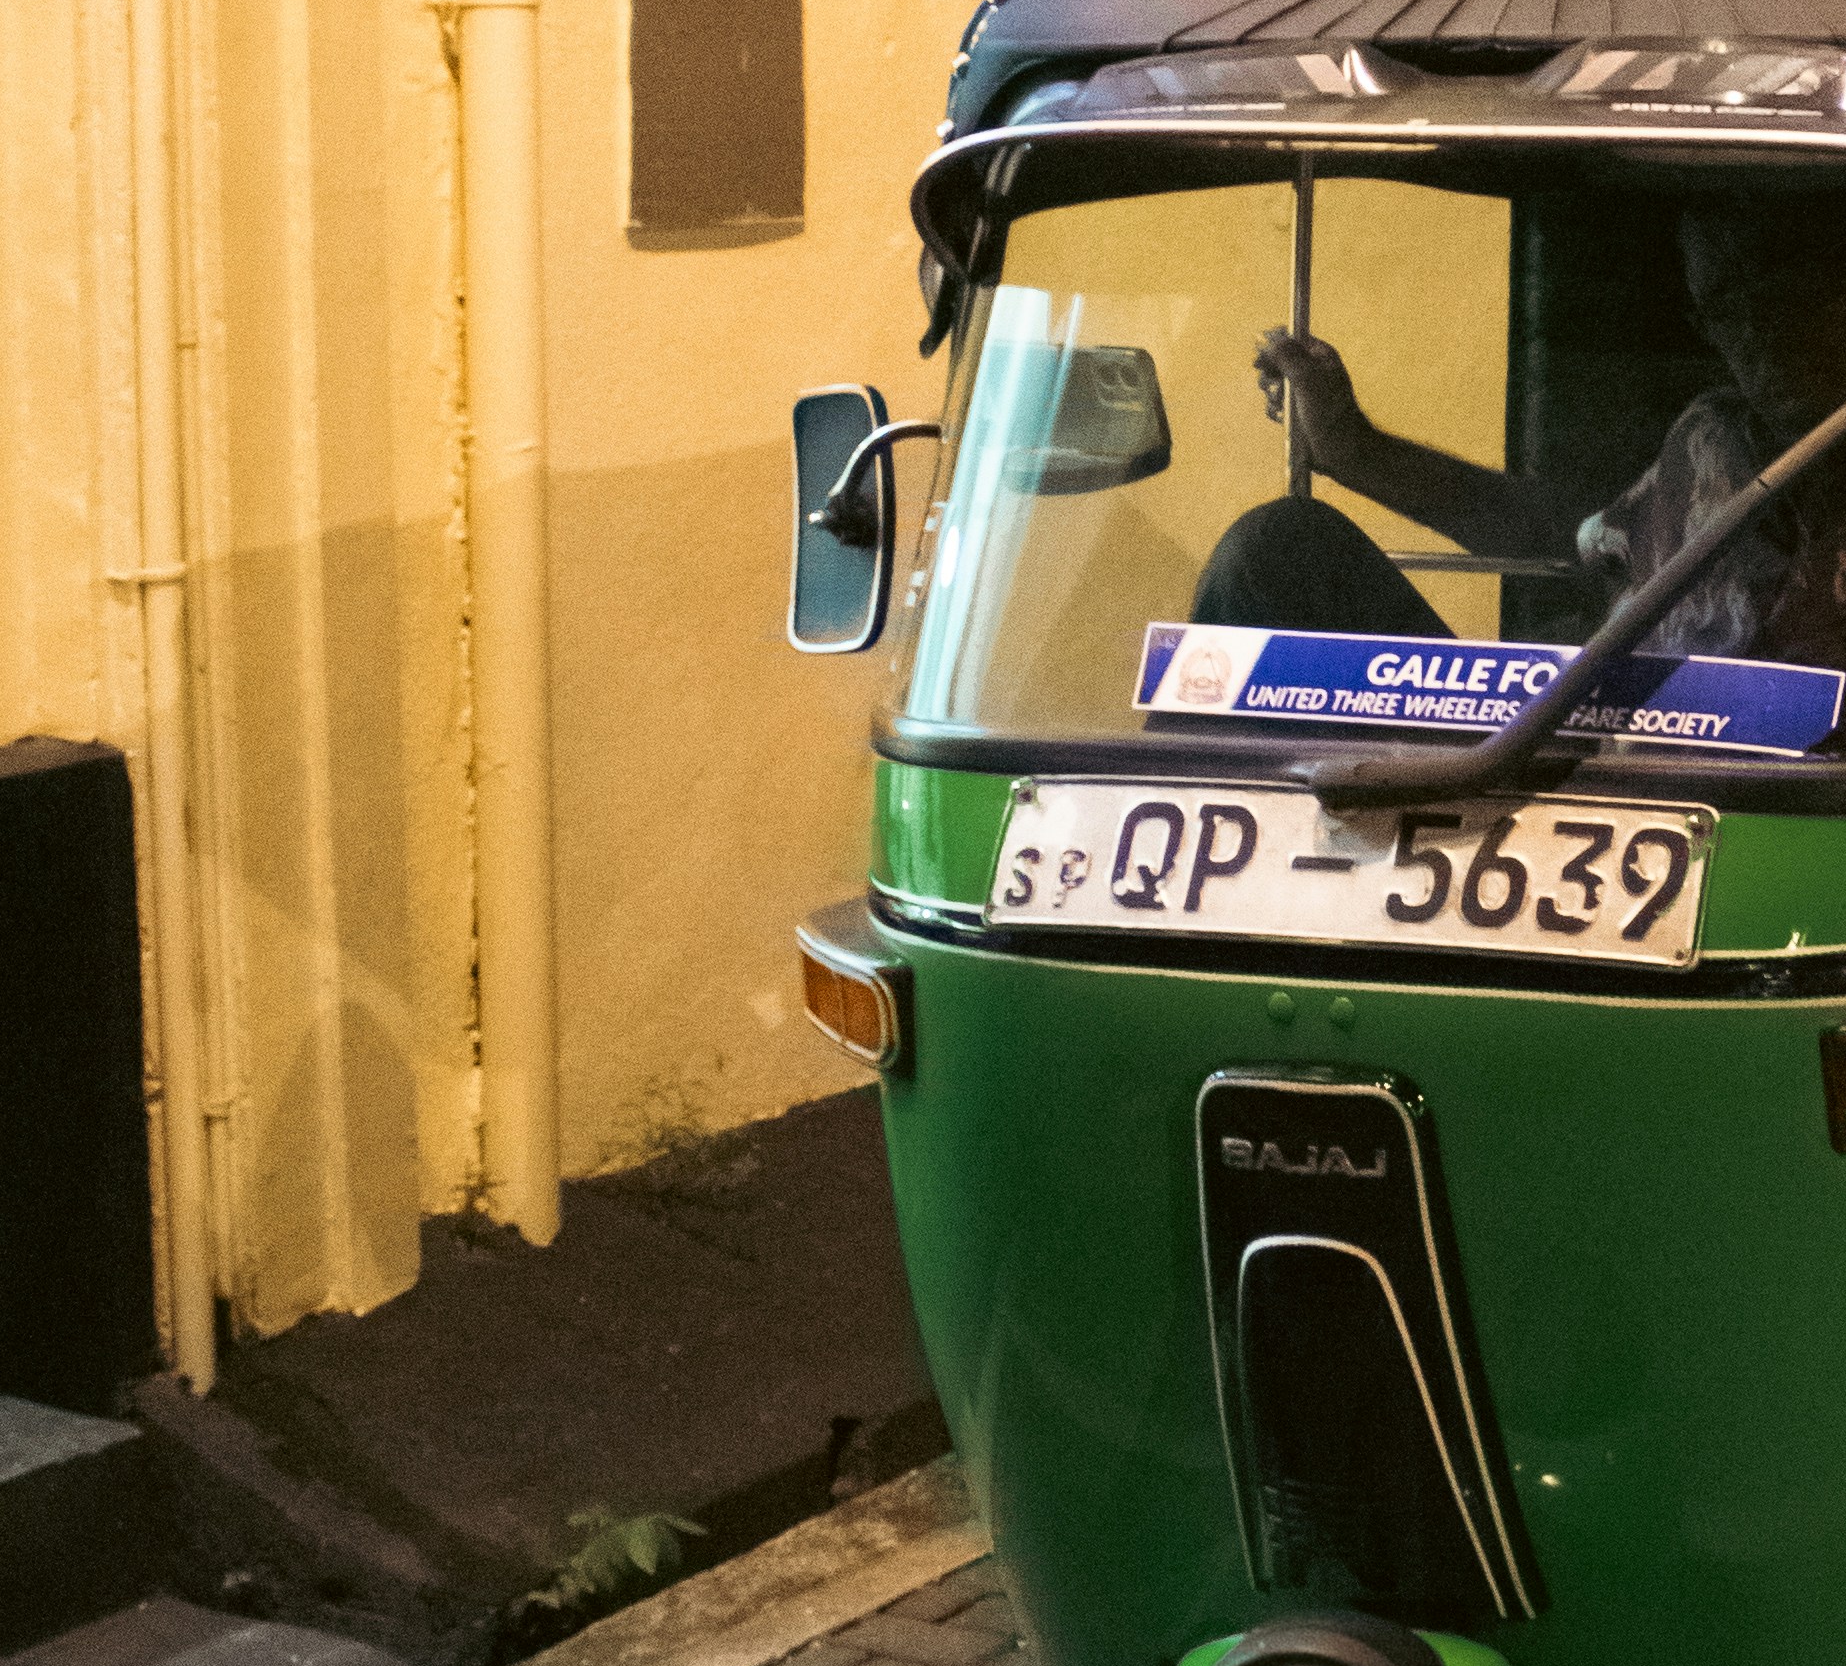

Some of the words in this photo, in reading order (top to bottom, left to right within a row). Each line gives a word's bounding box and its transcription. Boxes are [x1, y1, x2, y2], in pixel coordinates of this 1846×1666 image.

[1366, 653, 1497, 692] GALLE
[1246, 685, 1328, 711] UNITED
[1331, 689, 1402, 716] THREE
[1404, 694, 1521, 723] WHEELERS
[1629, 707, 1731, 738] SOCIETY
[1385, 812, 1690, 940] 5639
[1221, 1136, 1387, 1178] BAJAJ
